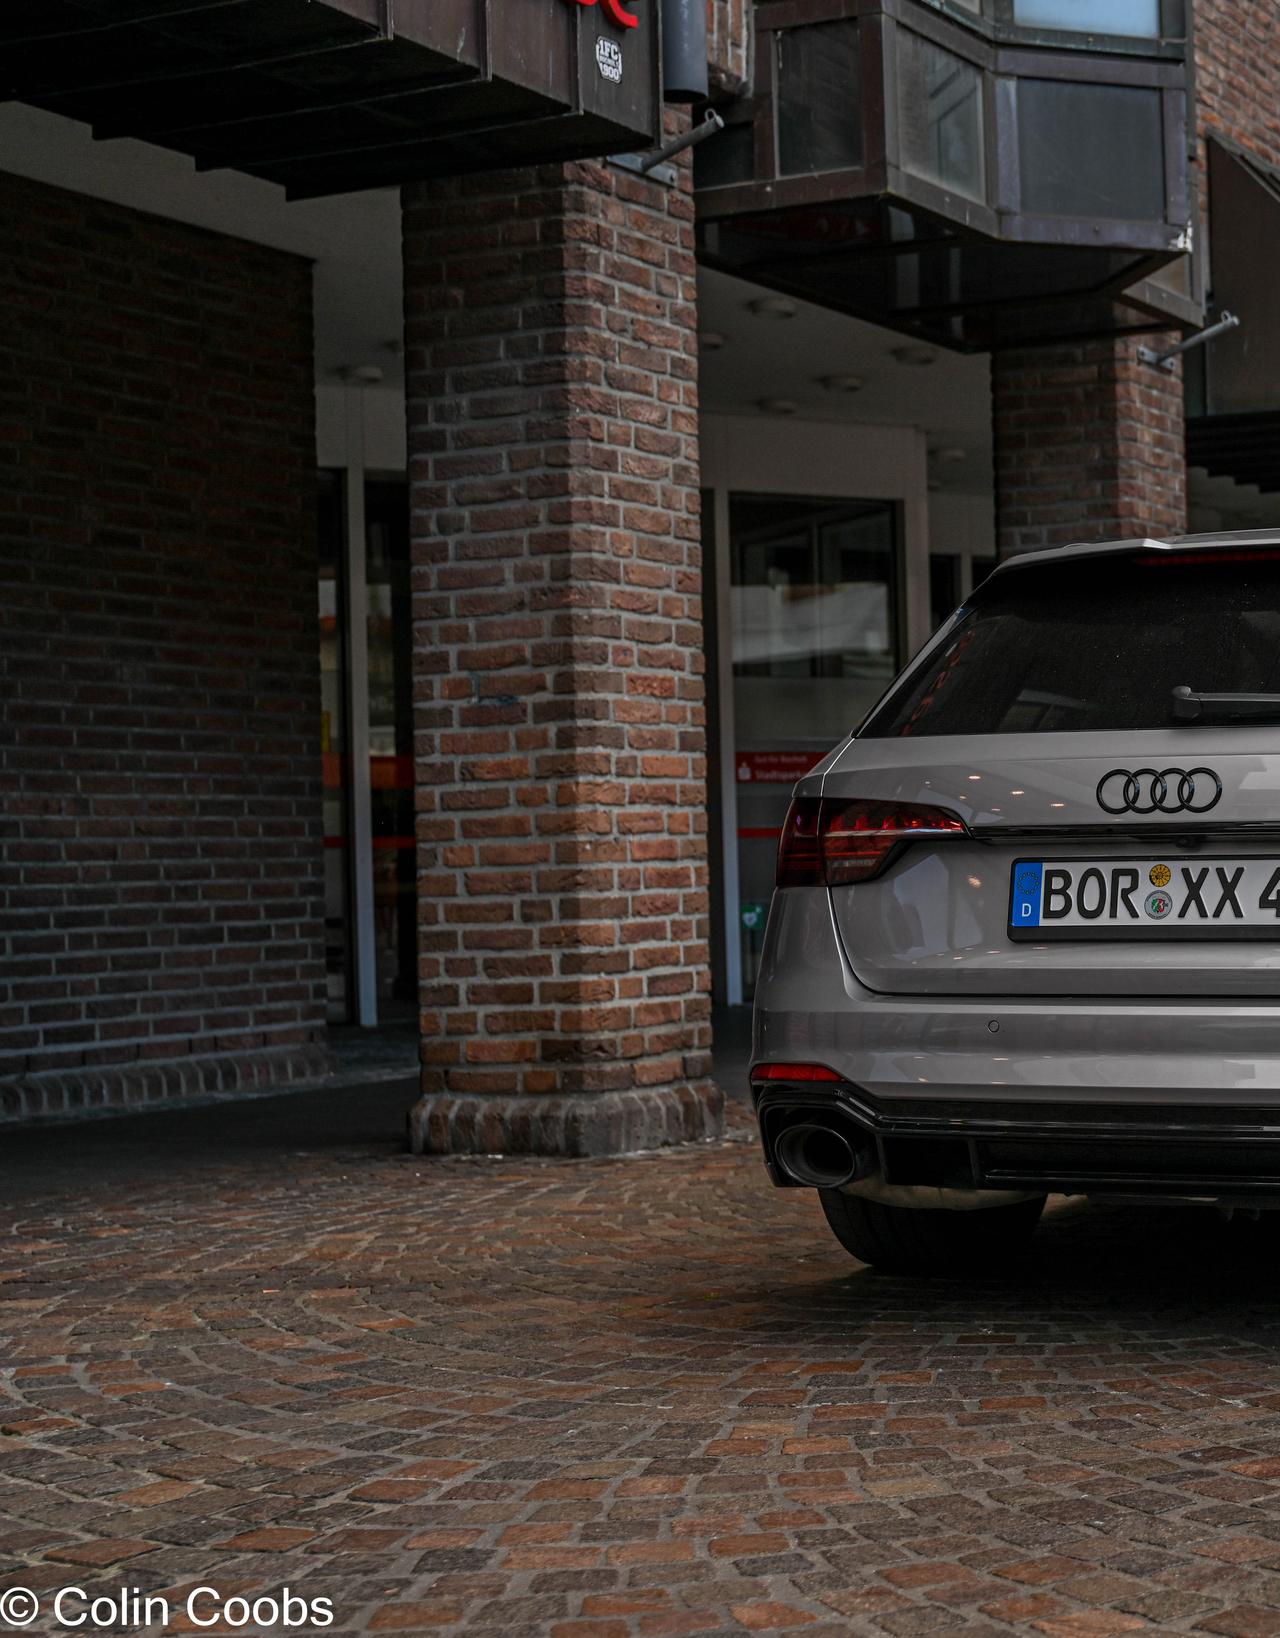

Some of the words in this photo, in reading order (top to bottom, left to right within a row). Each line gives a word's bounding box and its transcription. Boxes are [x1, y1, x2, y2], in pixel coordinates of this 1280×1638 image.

[1043, 867, 1139, 919] BOR
[1178, 867, 1245, 918] XX
[1021, 903, 1032, 917] D
